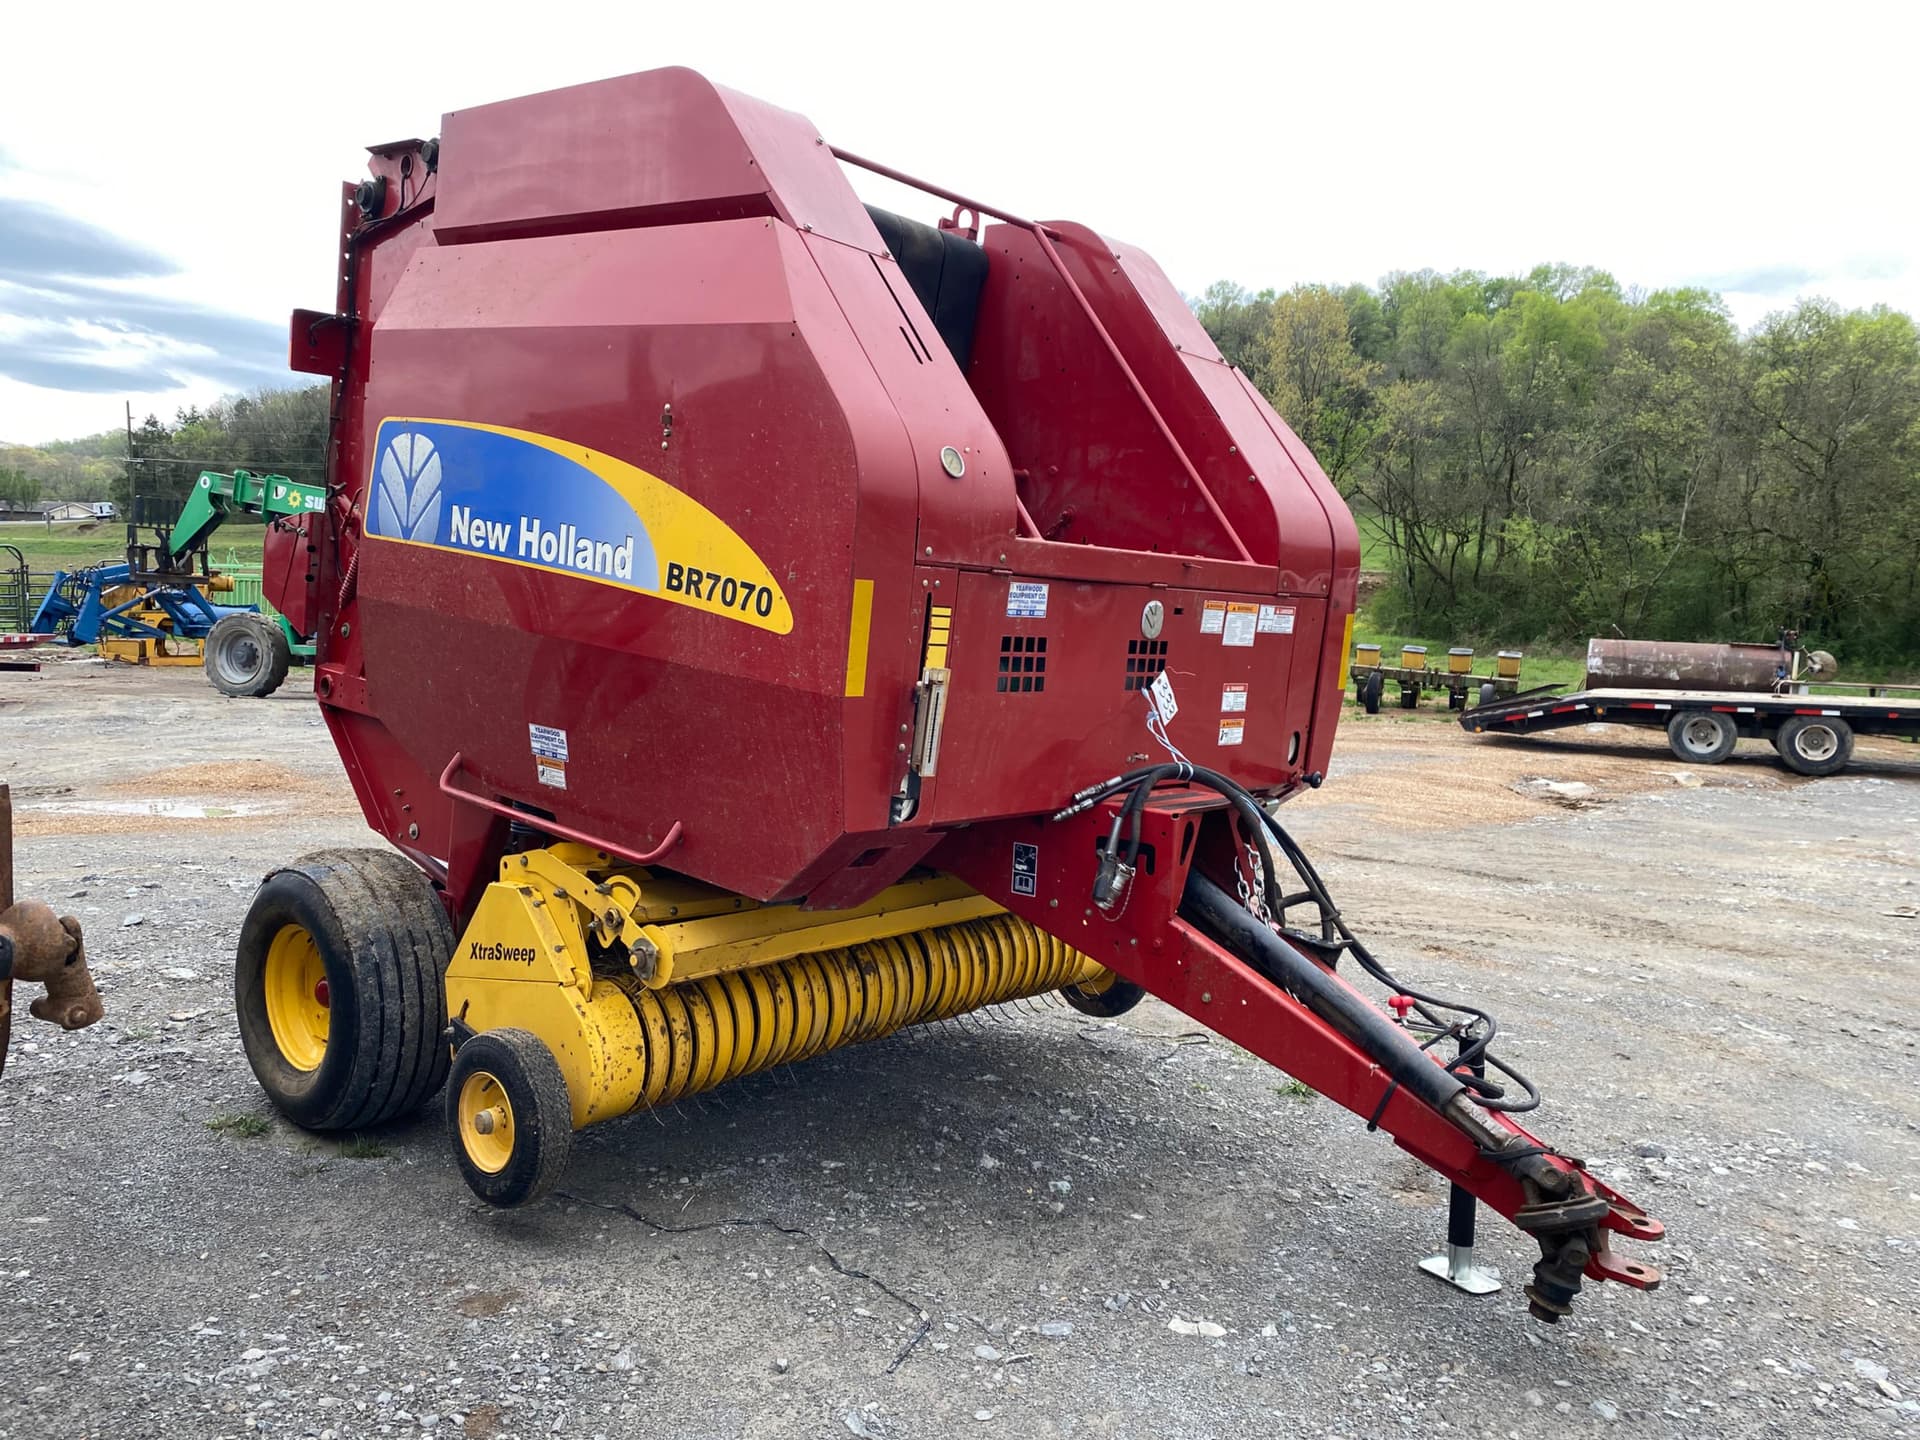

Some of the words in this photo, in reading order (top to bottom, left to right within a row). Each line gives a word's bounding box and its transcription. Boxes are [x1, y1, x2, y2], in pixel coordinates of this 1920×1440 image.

[304, 495, 325, 511] SU
[450, 505, 511, 551] New
[518, 516, 634, 580] Holland
[665, 562, 773, 618] BR7070
[470, 942, 536, 967] XtraSweep
